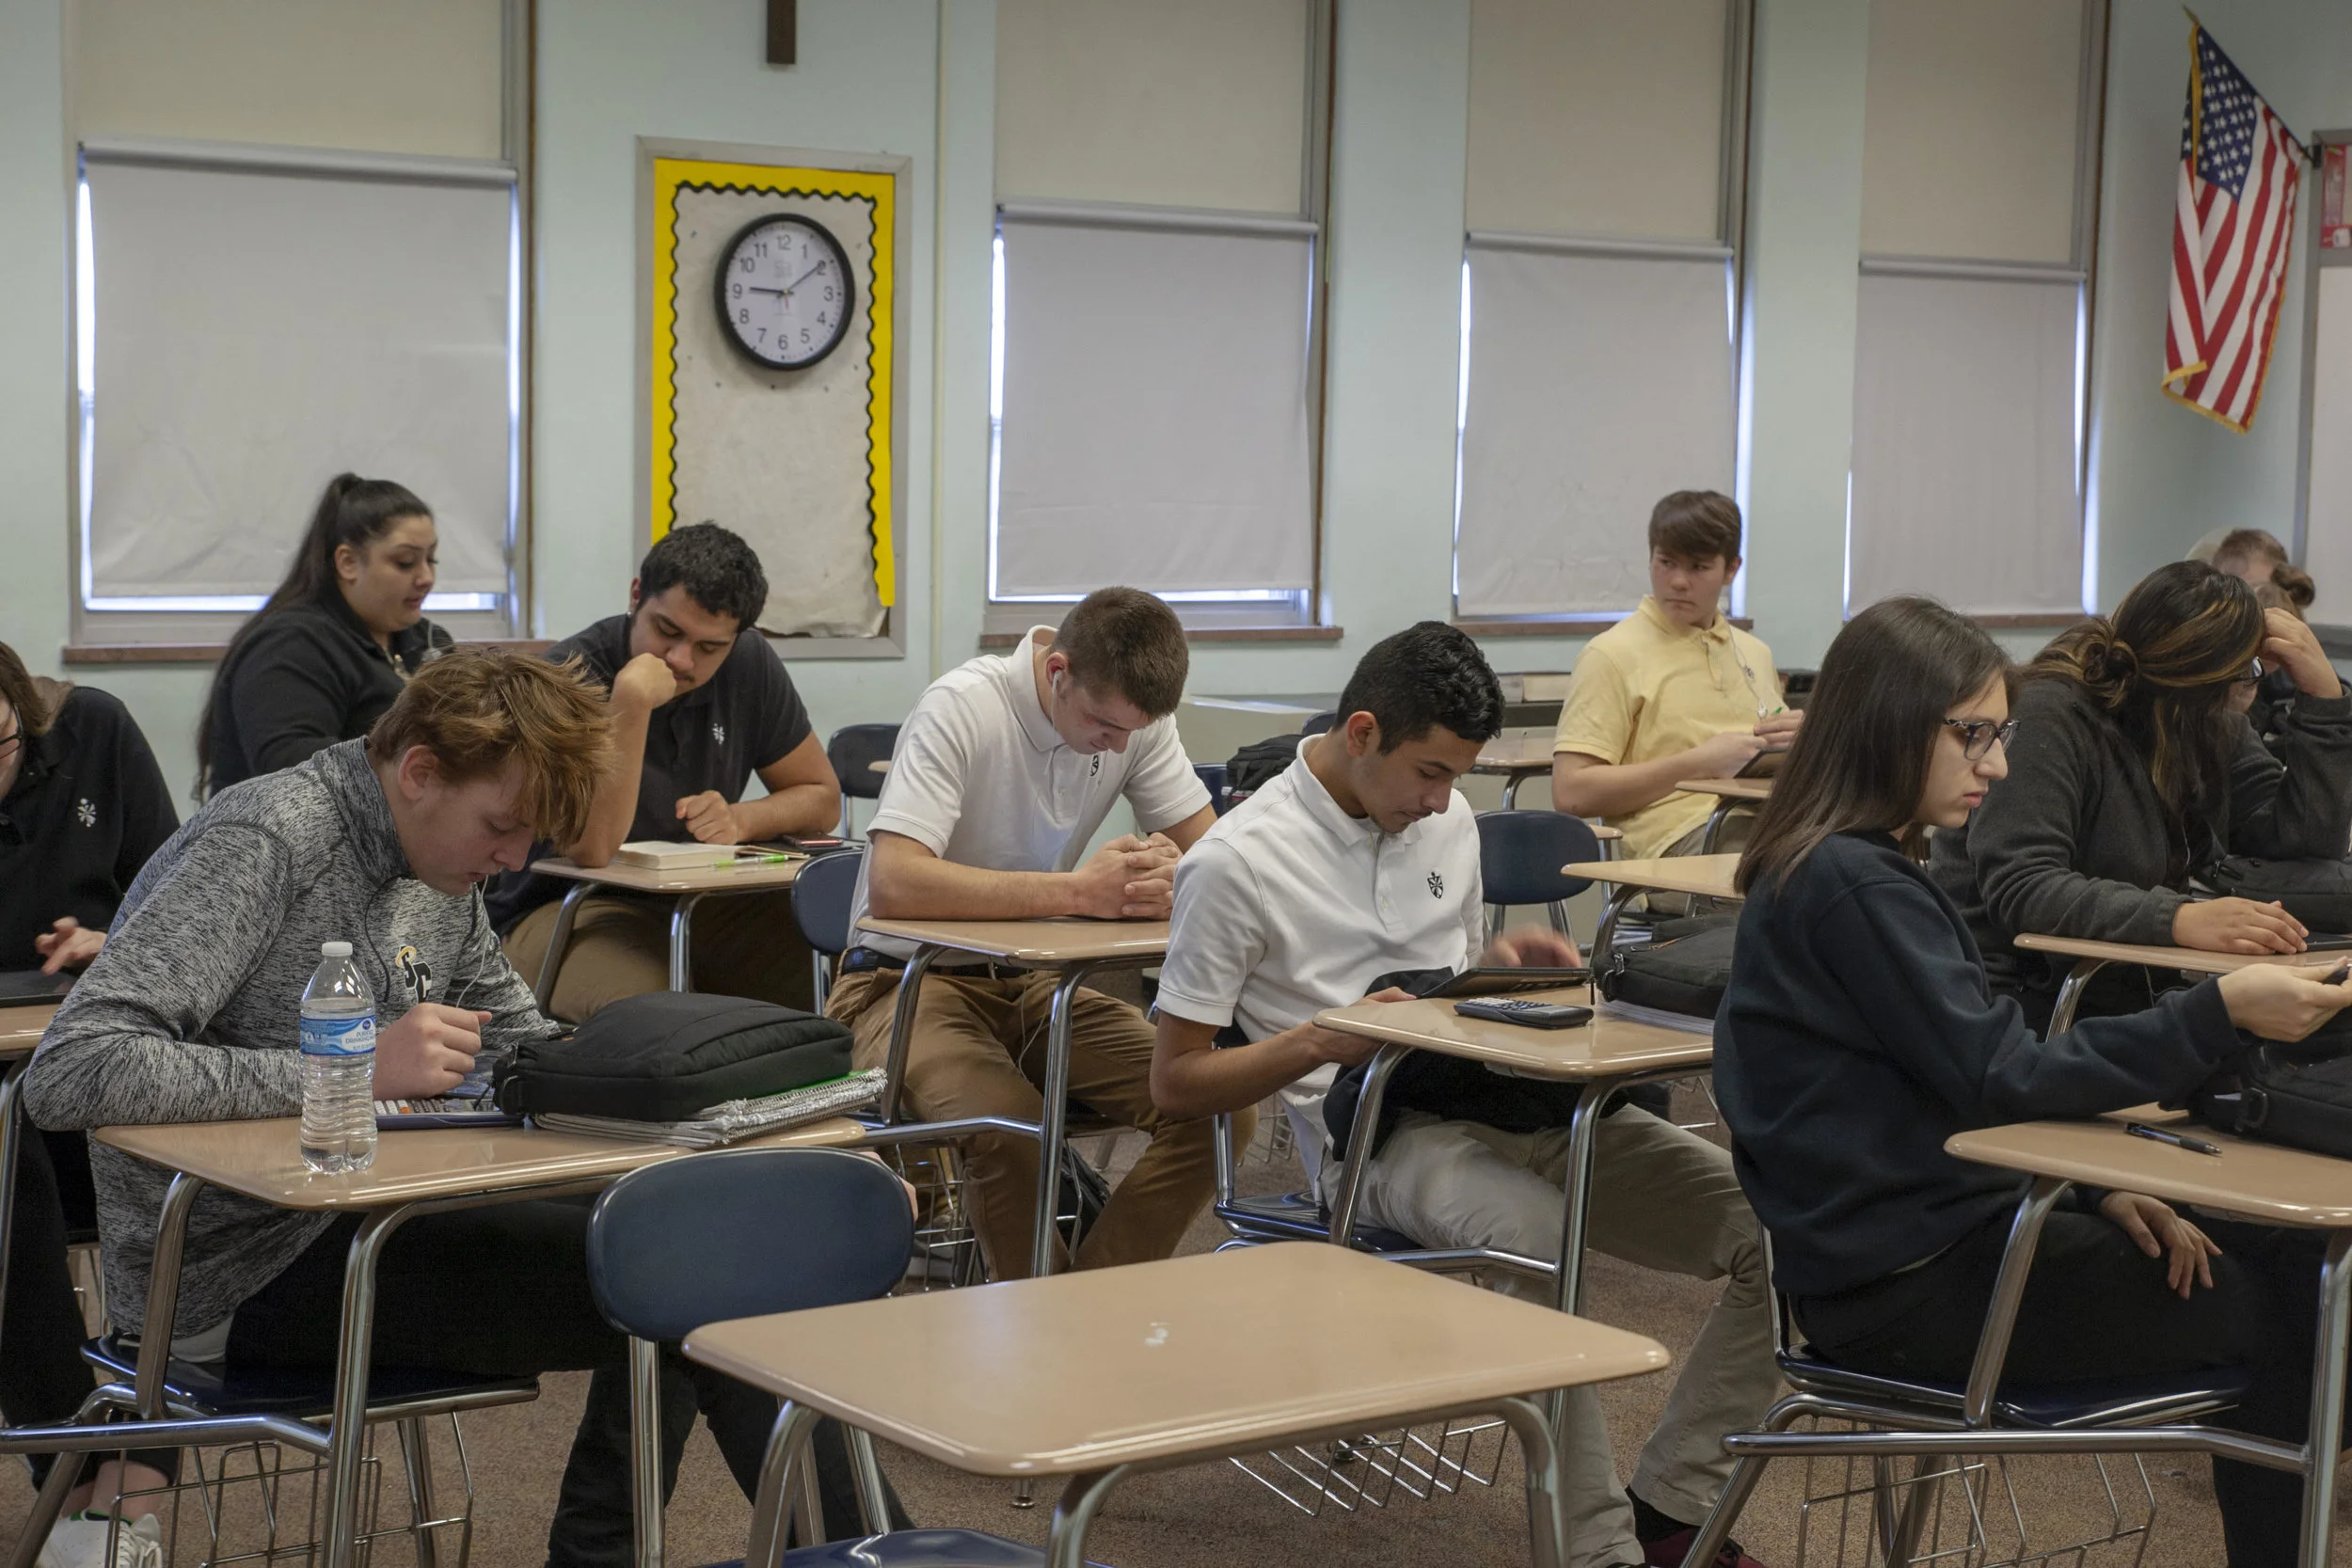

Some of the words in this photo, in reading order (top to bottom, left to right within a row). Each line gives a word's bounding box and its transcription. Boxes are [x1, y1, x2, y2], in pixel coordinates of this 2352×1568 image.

[776, 234, 791, 250] 12
[754, 242, 768, 258] 11
[802, 244, 808, 259] 1
[740, 257, 755, 273] 10
[817, 260, 826, 276] 2
[733, 283, 742, 299] 9
[823, 286, 834, 301] 3
[739, 309, 750, 324] 8
[817, 311, 826, 325] 4
[756, 327, 767, 342] 7
[801, 329, 810, 343] 5
[778, 335, 788, 350] 6
